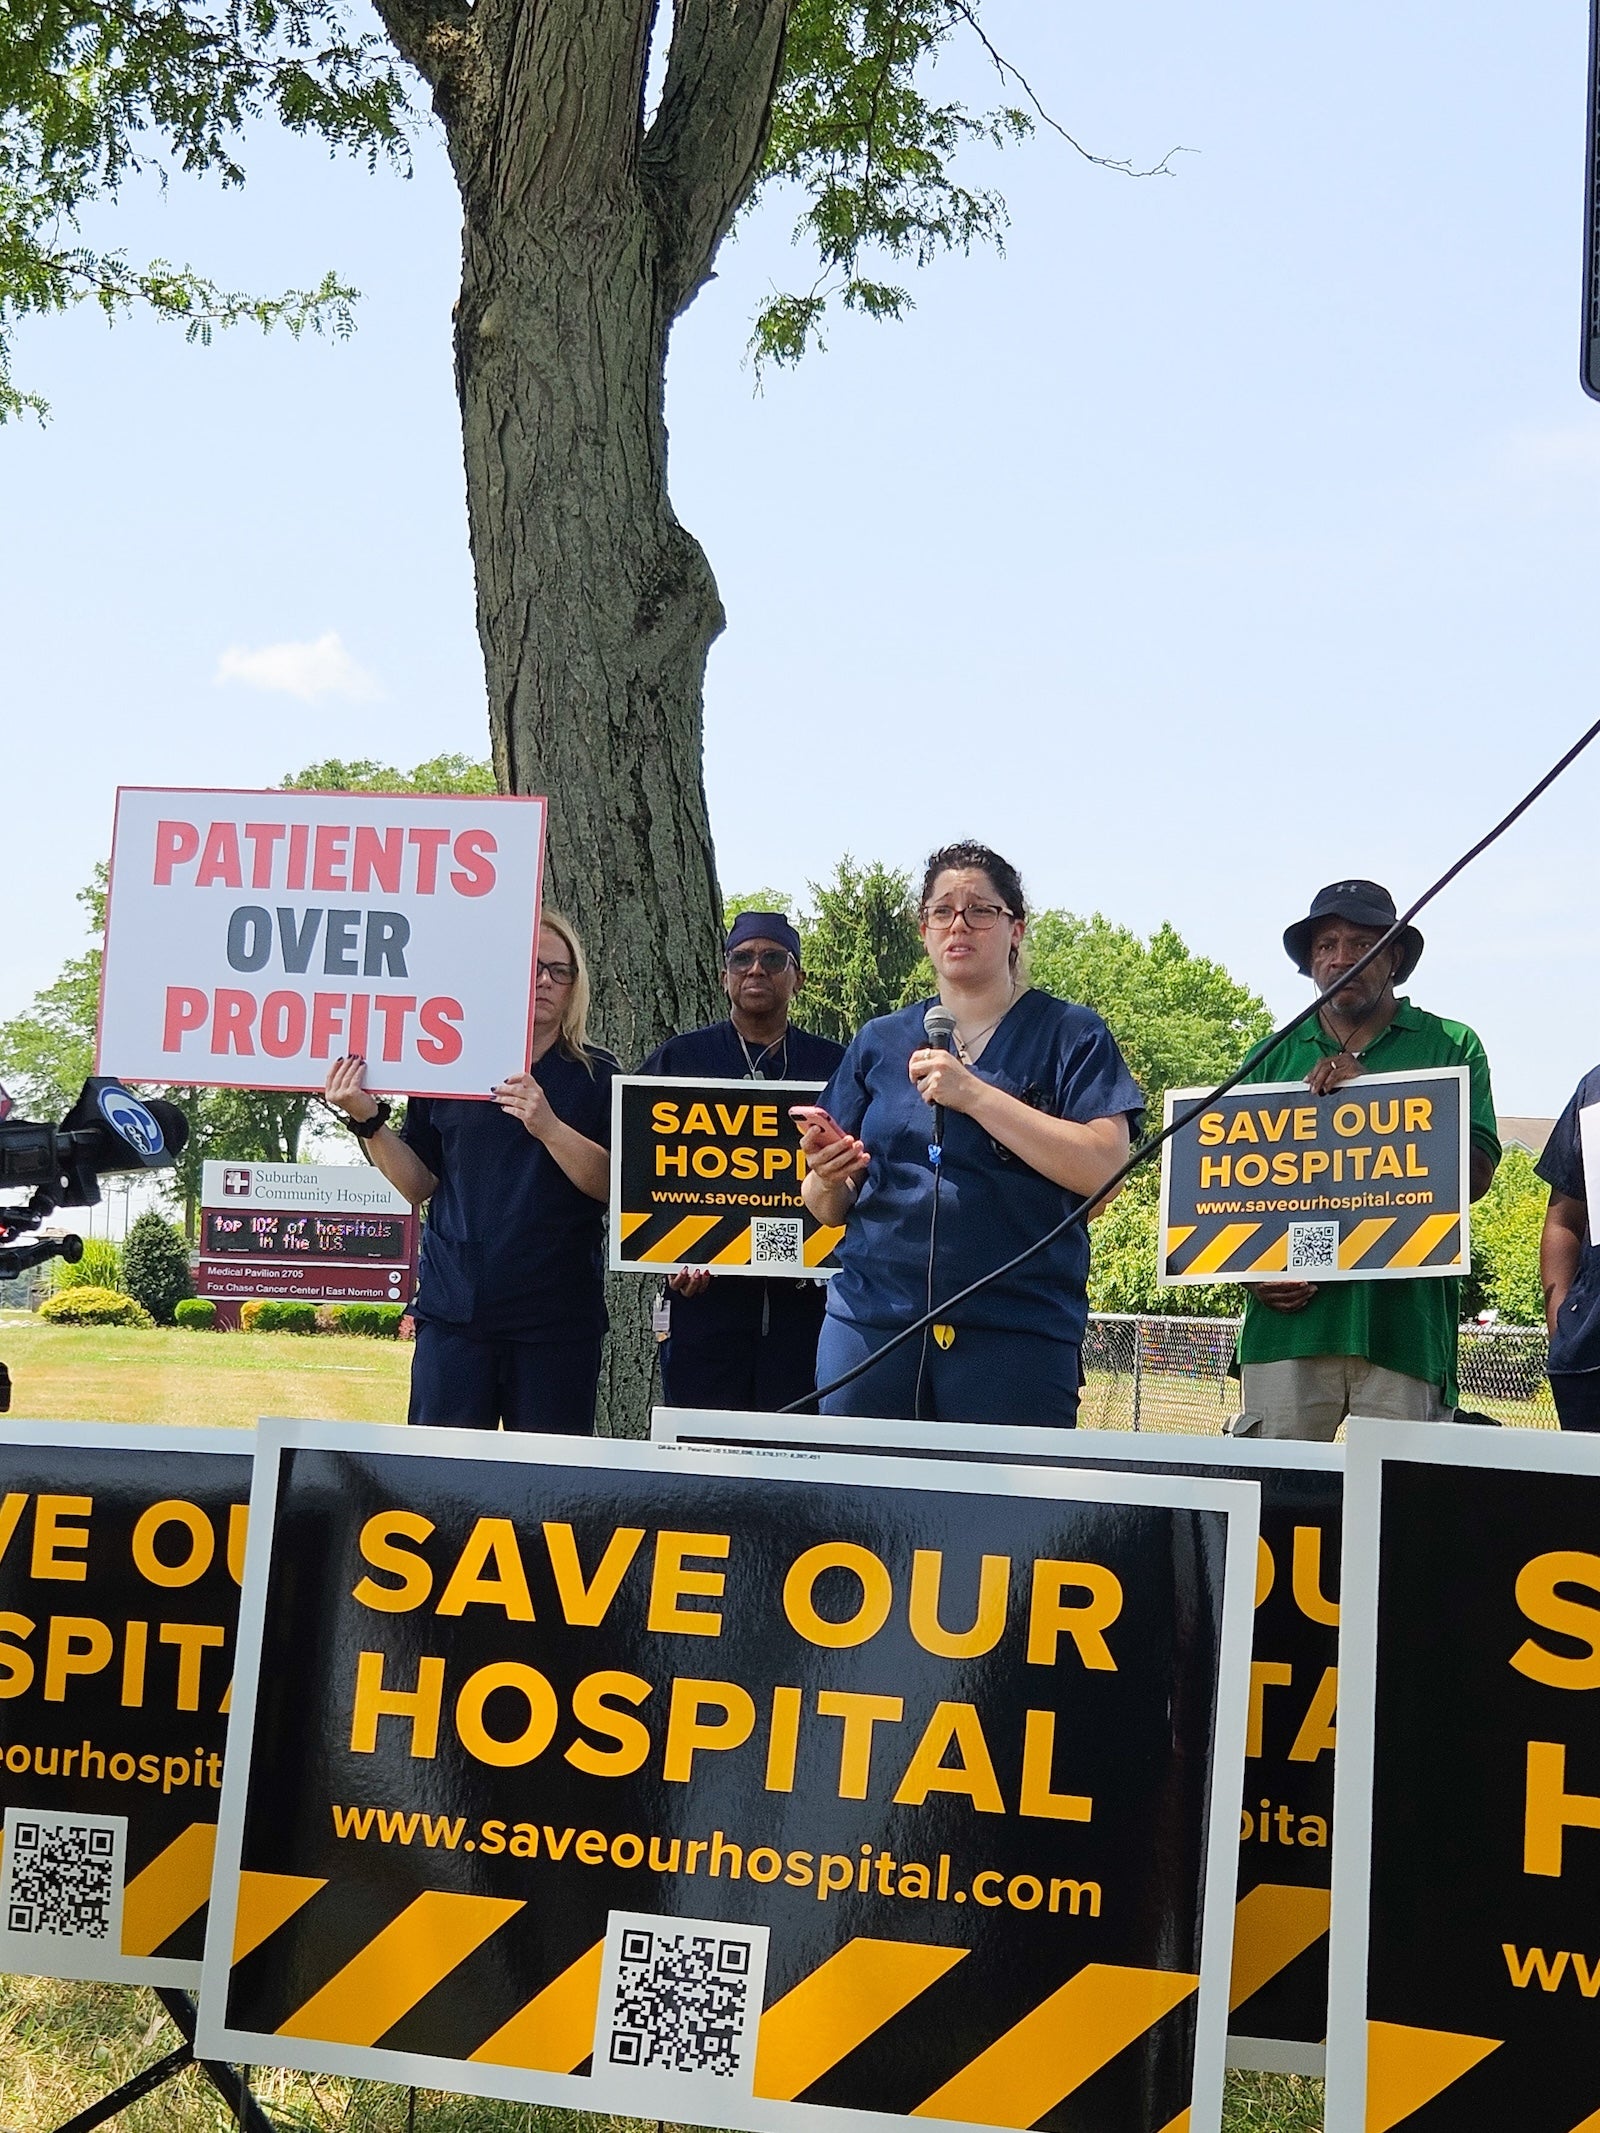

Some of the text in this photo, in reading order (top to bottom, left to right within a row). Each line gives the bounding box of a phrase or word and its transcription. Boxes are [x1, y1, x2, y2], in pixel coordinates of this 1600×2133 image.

[153, 820, 498, 898] PATIENTS
[227, 906, 410, 977] OVER
[162, 986, 464, 1066] PROFITS
[126, 1124, 149, 1154] abc
[652, 1102, 778, 1136] SAVE
[1200, 1097, 1432, 1144] SAVE OUR
[256, 1170, 318, 1184] Suburban
[1201, 1140, 1427, 1186] HOSPITAL
[255, 1186, 391, 1206] Community Hospital
[1199, 1191, 1430, 1213] www.saveourhospital.com
[215, 1216, 391, 1238] top 10% of hospitals
[259, 1233, 273, 1249] in
[283, 1234, 310, 1251] the
[207, 1267, 304, 1279] Medical Pavilion 2705
[207, 1282, 384, 1297] Fox Chase Cancer Center East Norriton
[352, 1510, 1123, 1671] SAVE OUR
[0, 1611, 232, 1713] SPIT
[350, 1651, 1093, 1822] HOSPITAL
[0, 1741, 222, 1793] ourhospit
[332, 1805, 1102, 1917] www.saveourhospital.com
